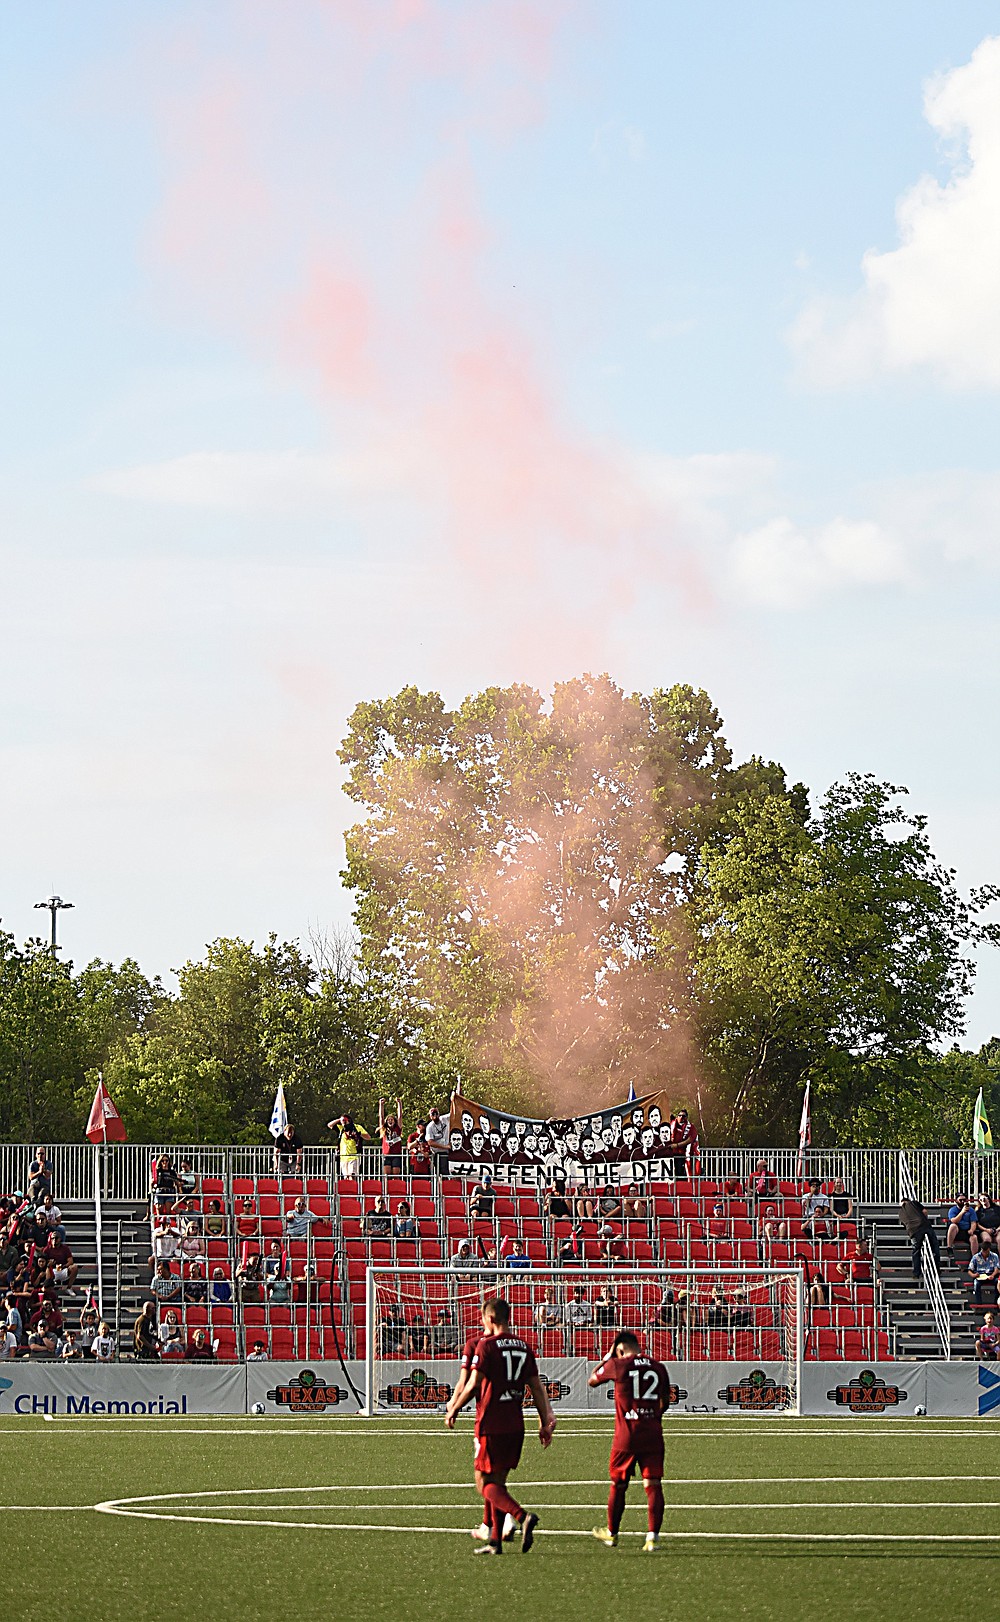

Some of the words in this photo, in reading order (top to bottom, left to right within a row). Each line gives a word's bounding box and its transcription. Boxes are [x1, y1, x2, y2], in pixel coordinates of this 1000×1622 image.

[451, 1163, 567, 1185] #DEFEND
[577, 1163, 620, 1185] THE
[632, 1159, 673, 1182] DEN
[502, 1350, 527, 1381] 17
[391, 1386, 449, 1402] TEXAS
[628, 1370, 659, 1400] 12
[14, 1394, 57, 1414] CHI
[66, 1394, 187, 1414] Memorial
[279, 1387, 337, 1403] TEXAS
[729, 1387, 787, 1403] TEXAS
[840, 1387, 897, 1403] TEXAS
